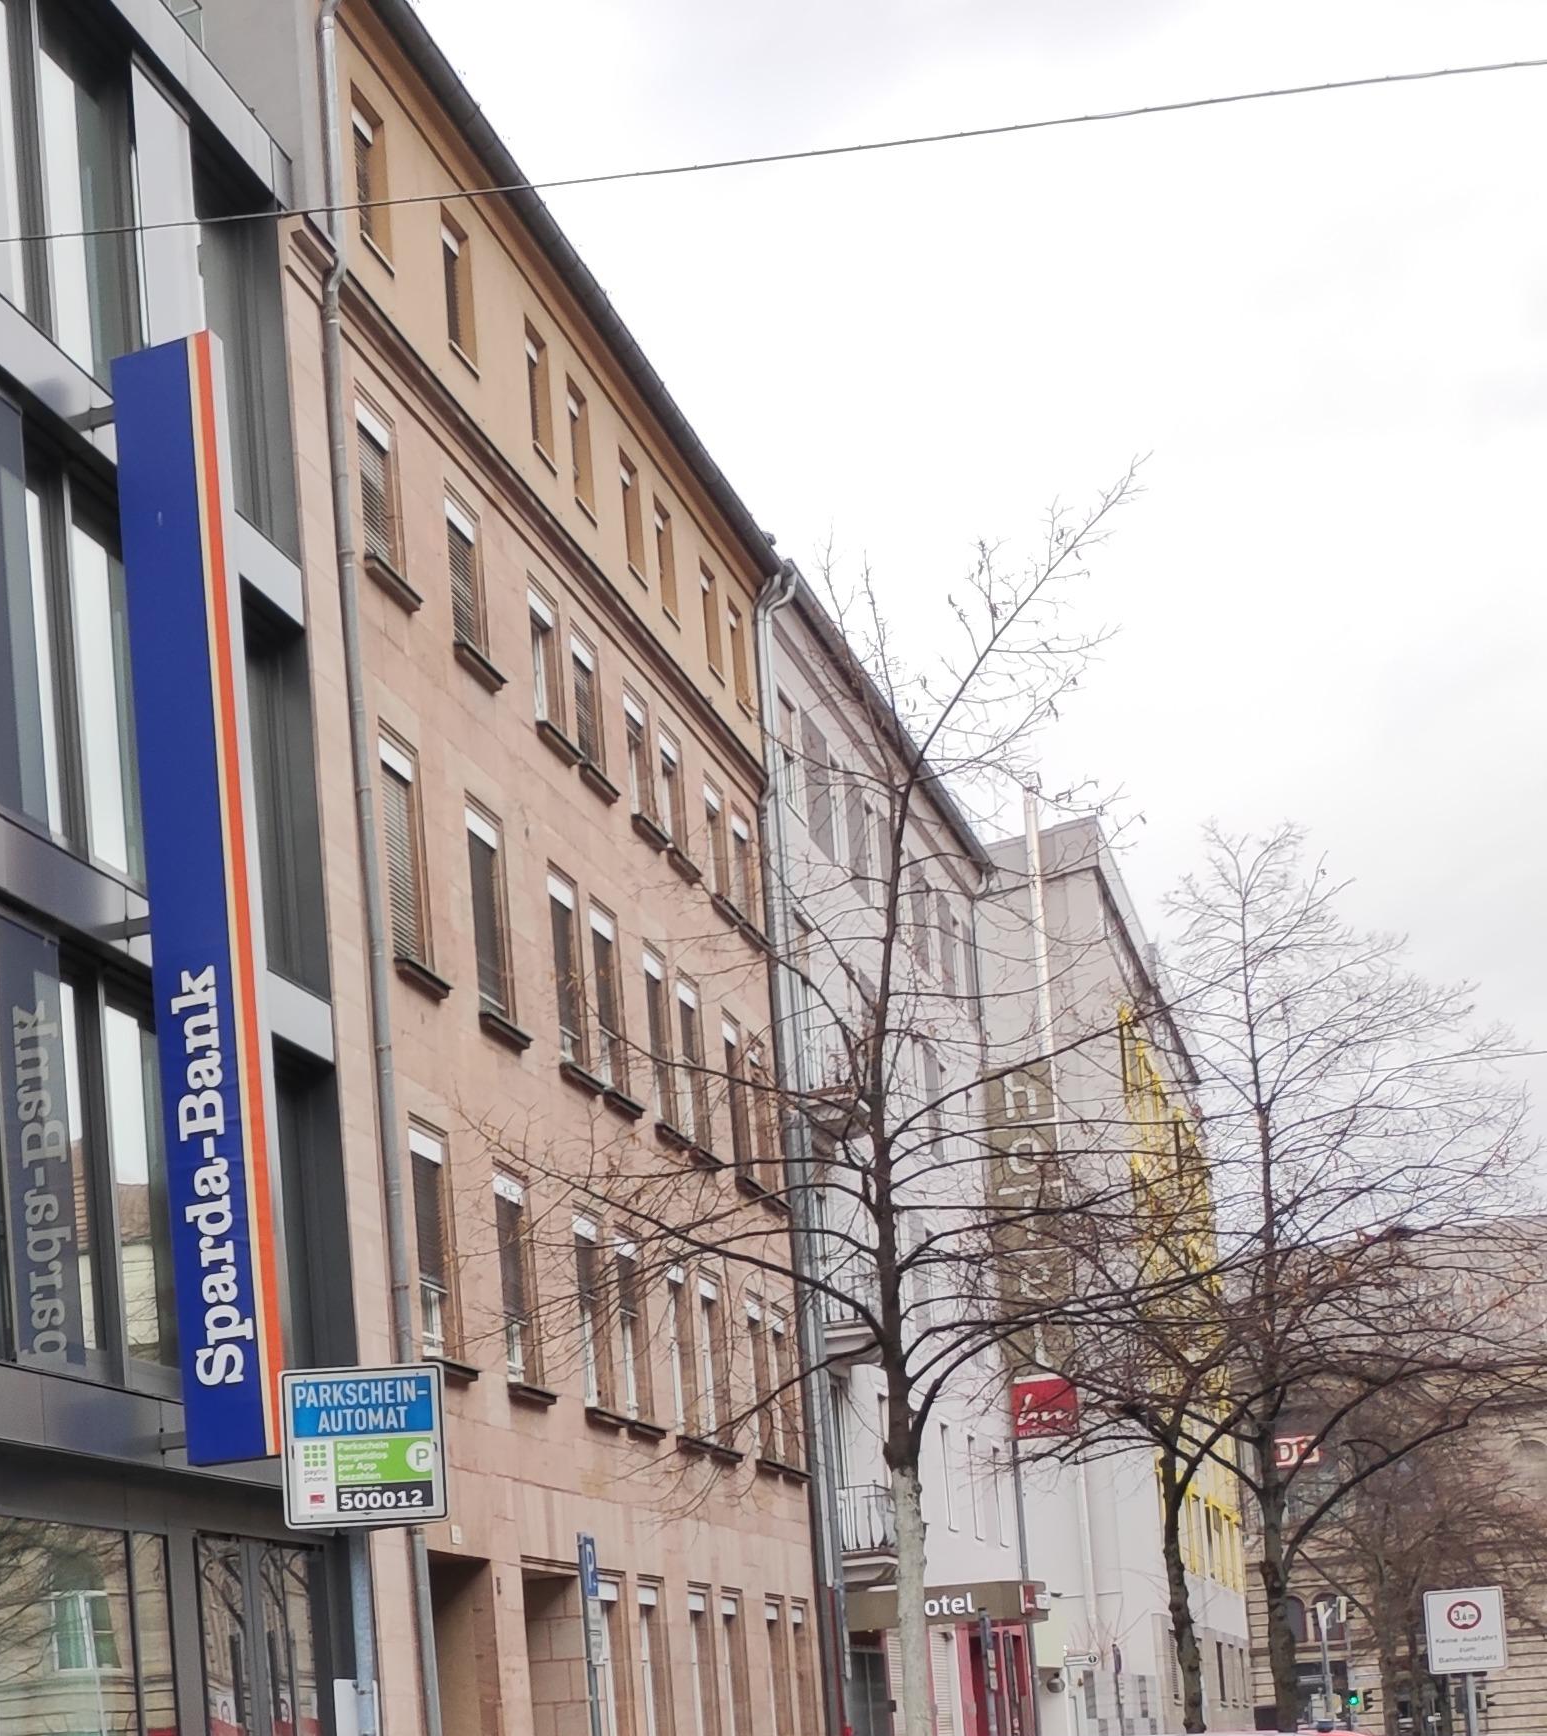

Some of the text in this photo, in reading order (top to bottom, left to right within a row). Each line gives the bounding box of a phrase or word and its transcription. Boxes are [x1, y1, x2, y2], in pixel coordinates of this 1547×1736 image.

[172, 965, 254, 1386] Sparda-Bank
[294, 1379, 428, 1408] PARKSCHEIN-
[317, 1406, 408, 1433] AUTOMAT
[356, 1462, 377, 1472] App
[340, 1489, 424, 1510] 500012
[924, 1592, 975, 1617] otel
